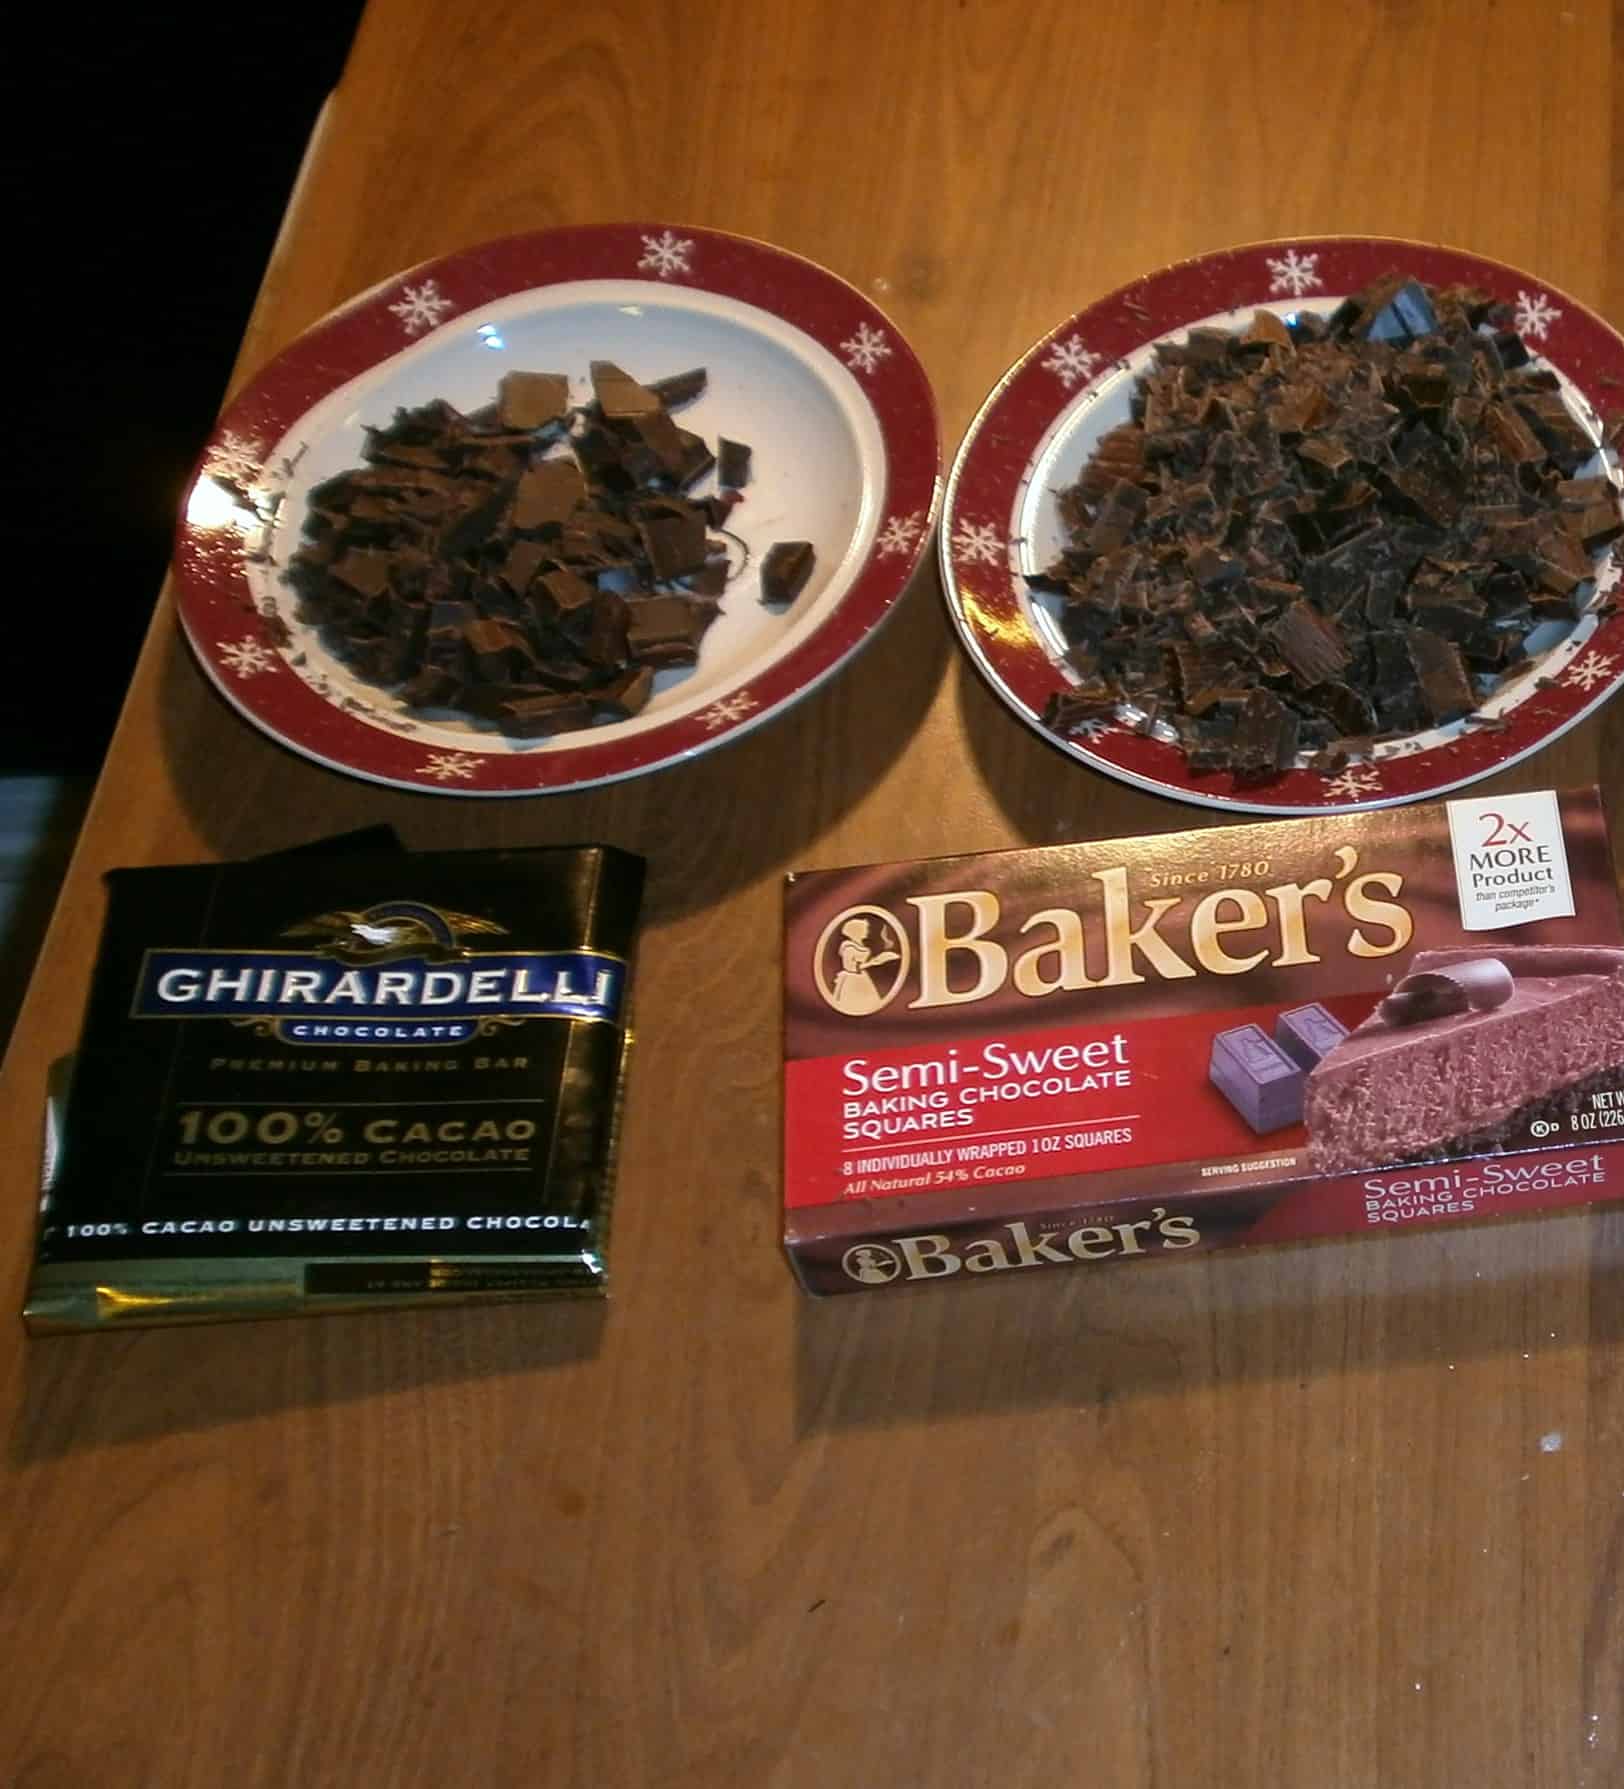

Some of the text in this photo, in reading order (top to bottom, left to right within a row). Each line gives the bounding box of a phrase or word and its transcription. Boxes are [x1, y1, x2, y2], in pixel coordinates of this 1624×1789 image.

[1480, 813, 1533, 847] 2x
[1471, 845, 1553, 871] MORE
[1150, 860, 1270, 887] Since 1780
[1472, 868, 1554, 889] Product
[1476, 890, 1496, 902] than
[905, 846, 1413, 1010] Baker's
[157, 968, 613, 1006] GHIRARDELLI
[292, 1025, 465, 1039] CHOCOLATE
[209, 1056, 528, 1072] PREMIUM BAKING BAR
[842, 1034, 1130, 1096] Semi-Sweet
[843, 1070, 1131, 1119] BAKING CHOCOLATE
[1592, 1091, 1614, 1110] NET
[179, 1111, 537, 1145] 100% CACAO
[843, 1109, 974, 1140] SQUARES
[1570, 1114, 1579, 1131] 8
[1581, 1112, 1597, 1130] OZ
[174, 1147, 530, 1166] UNSWEETENED CHOCOLATE
[842, 1161, 853, 1175] 8
[857, 1150, 953, 1174] INDIVIDUALLY
[958, 1140, 1026, 1161] WRAPPED
[1065, 1128, 1133, 1150] SQUARES
[844, 1165, 1025, 1195] All Natural 54% Cacao
[1364, 1154, 1604, 1200] Semi-Sweet
[1366, 1171, 1606, 1212] BAKING CHOCOLATE
[1367, 1200, 1475, 1223] SQUARES
[67, 1222, 128, 1238] 100%
[141, 1220, 236, 1235] CACAO
[248, 1216, 455, 1232] UNSWEETENED
[891, 1207, 1202, 1281] Baker's
